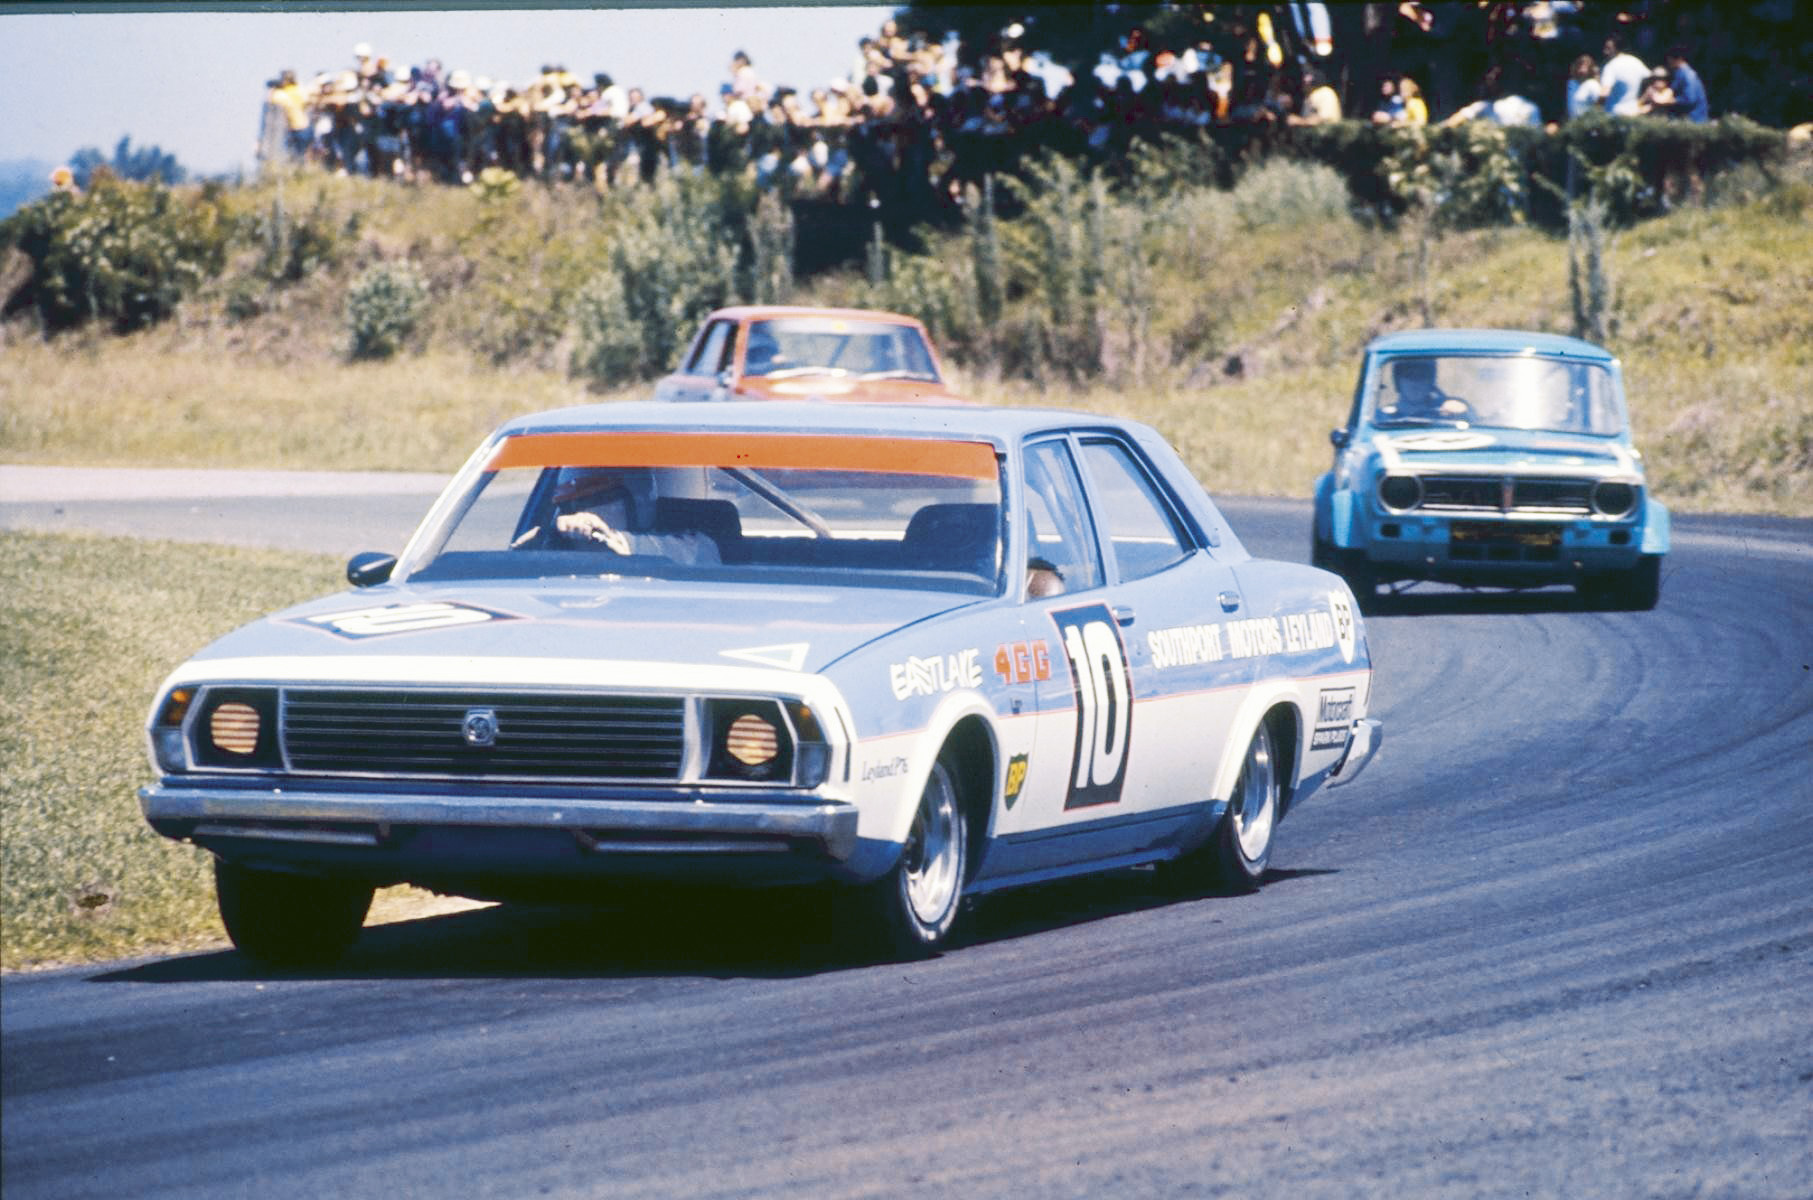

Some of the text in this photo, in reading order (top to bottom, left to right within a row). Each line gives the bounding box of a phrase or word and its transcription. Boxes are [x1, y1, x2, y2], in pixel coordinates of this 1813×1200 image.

[994, 639, 1050, 685] 4GG
[1147, 611, 1336, 669] SOUTHPORT MOTORS LEYLAND
[890, 648, 984, 701] EASTLAKE
[1064, 620, 1130, 789] 10
[1006, 760, 1026, 796] BP
